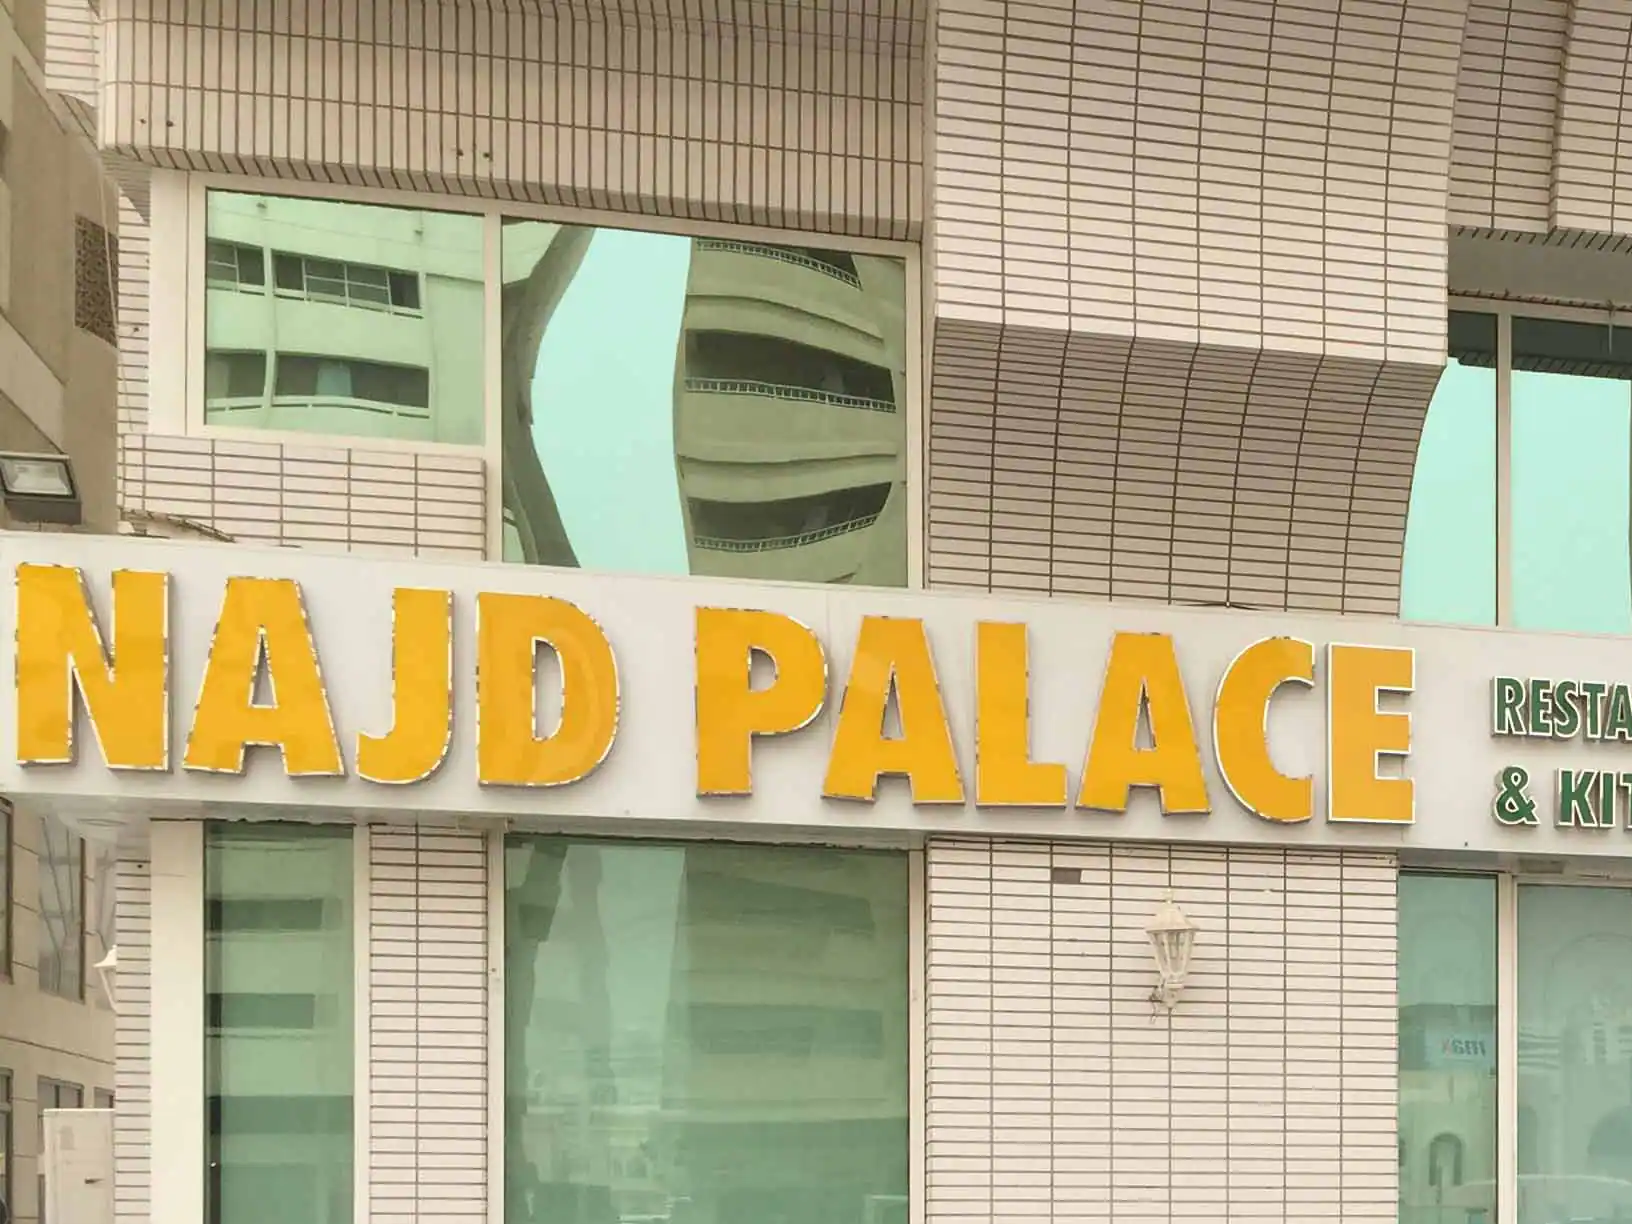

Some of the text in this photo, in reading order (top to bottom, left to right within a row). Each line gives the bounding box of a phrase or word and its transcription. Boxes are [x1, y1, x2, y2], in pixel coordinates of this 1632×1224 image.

[15, 561, 1416, 825] NAJD PALACE
[1493, 765, 1541, 826] &
